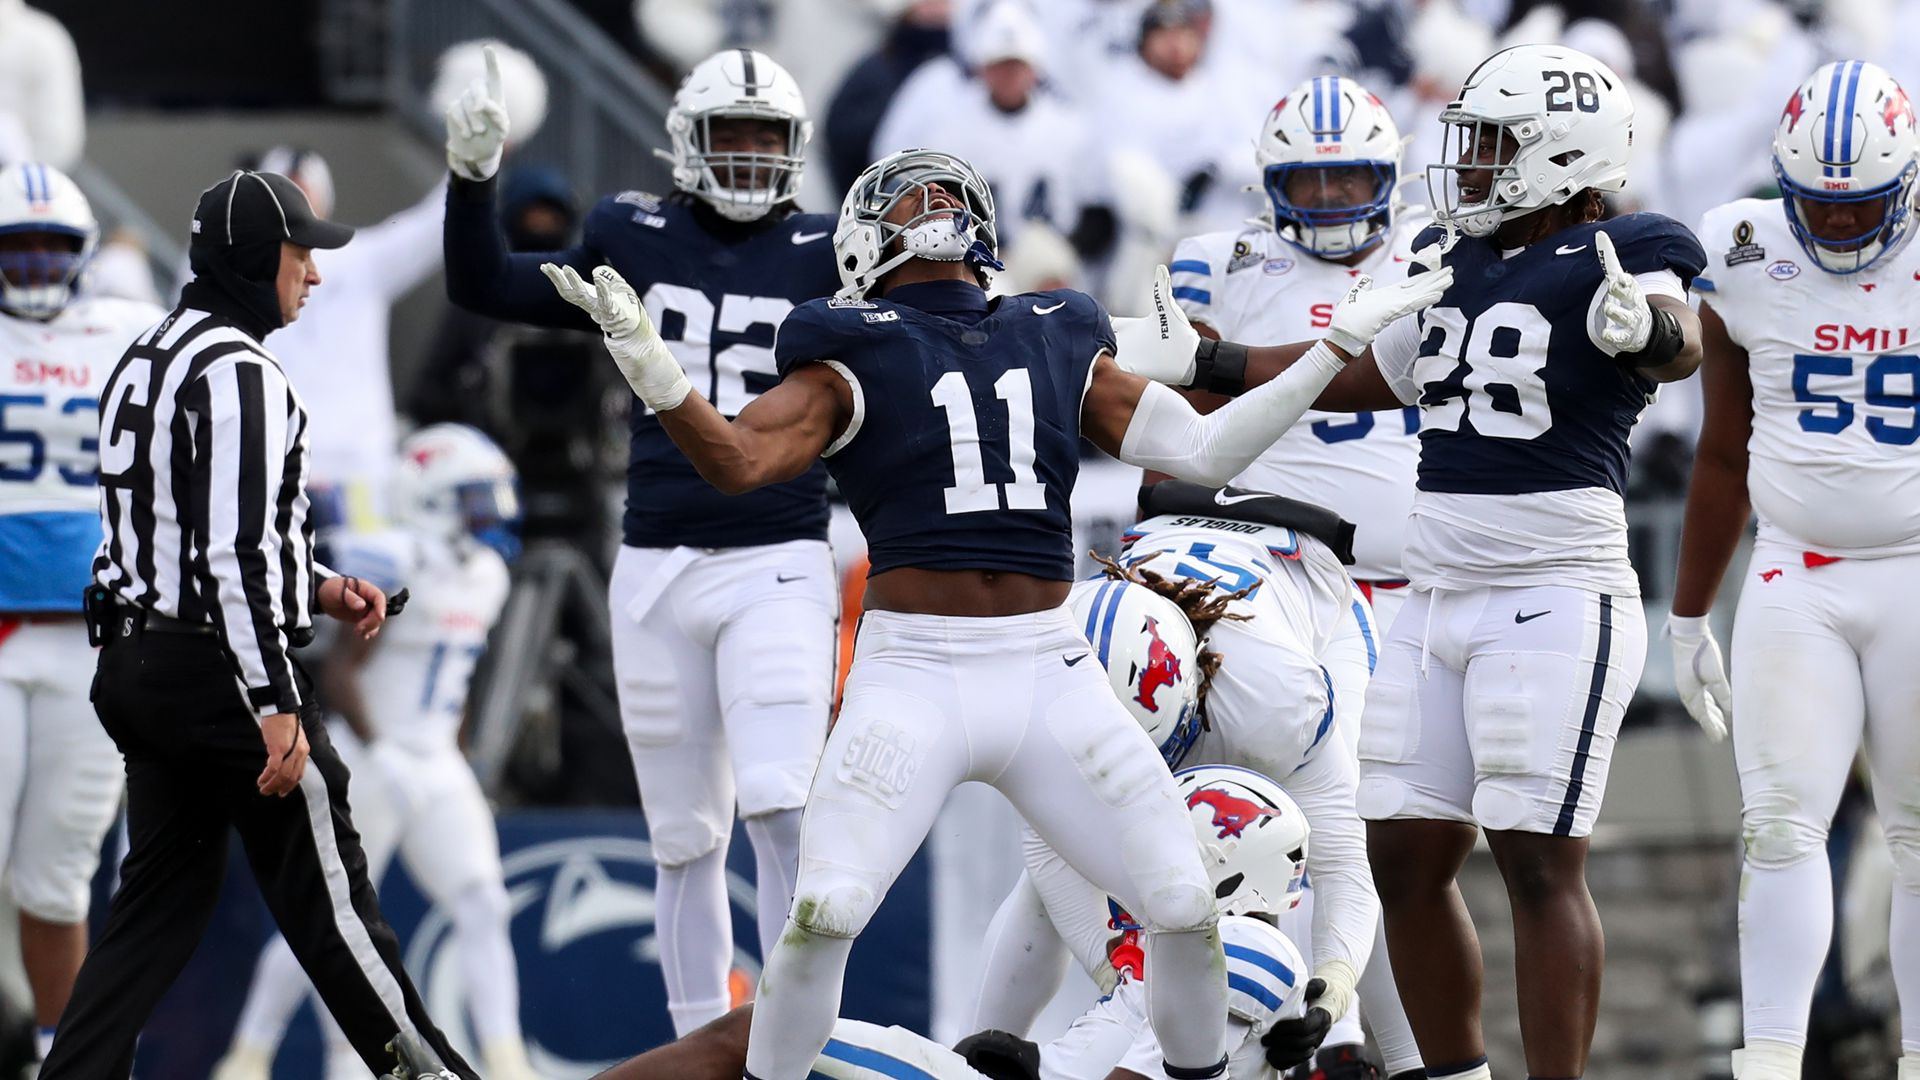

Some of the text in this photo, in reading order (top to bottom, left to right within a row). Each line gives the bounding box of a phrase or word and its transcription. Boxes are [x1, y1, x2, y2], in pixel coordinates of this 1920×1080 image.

[1542, 71, 1599, 113] 28
[1823, 181, 1850, 191] SMU
[643, 282, 796, 416] 92
[1159, 313, 1169, 340] PENN
[15, 359, 90, 387] SMU
[1412, 302, 1552, 440] 28
[1792, 354, 1920, 446] 59
[930, 368, 1048, 514] 11
[1169, 517, 1265, 535] DOUGLAS
[843, 735, 914, 794] STICKS
